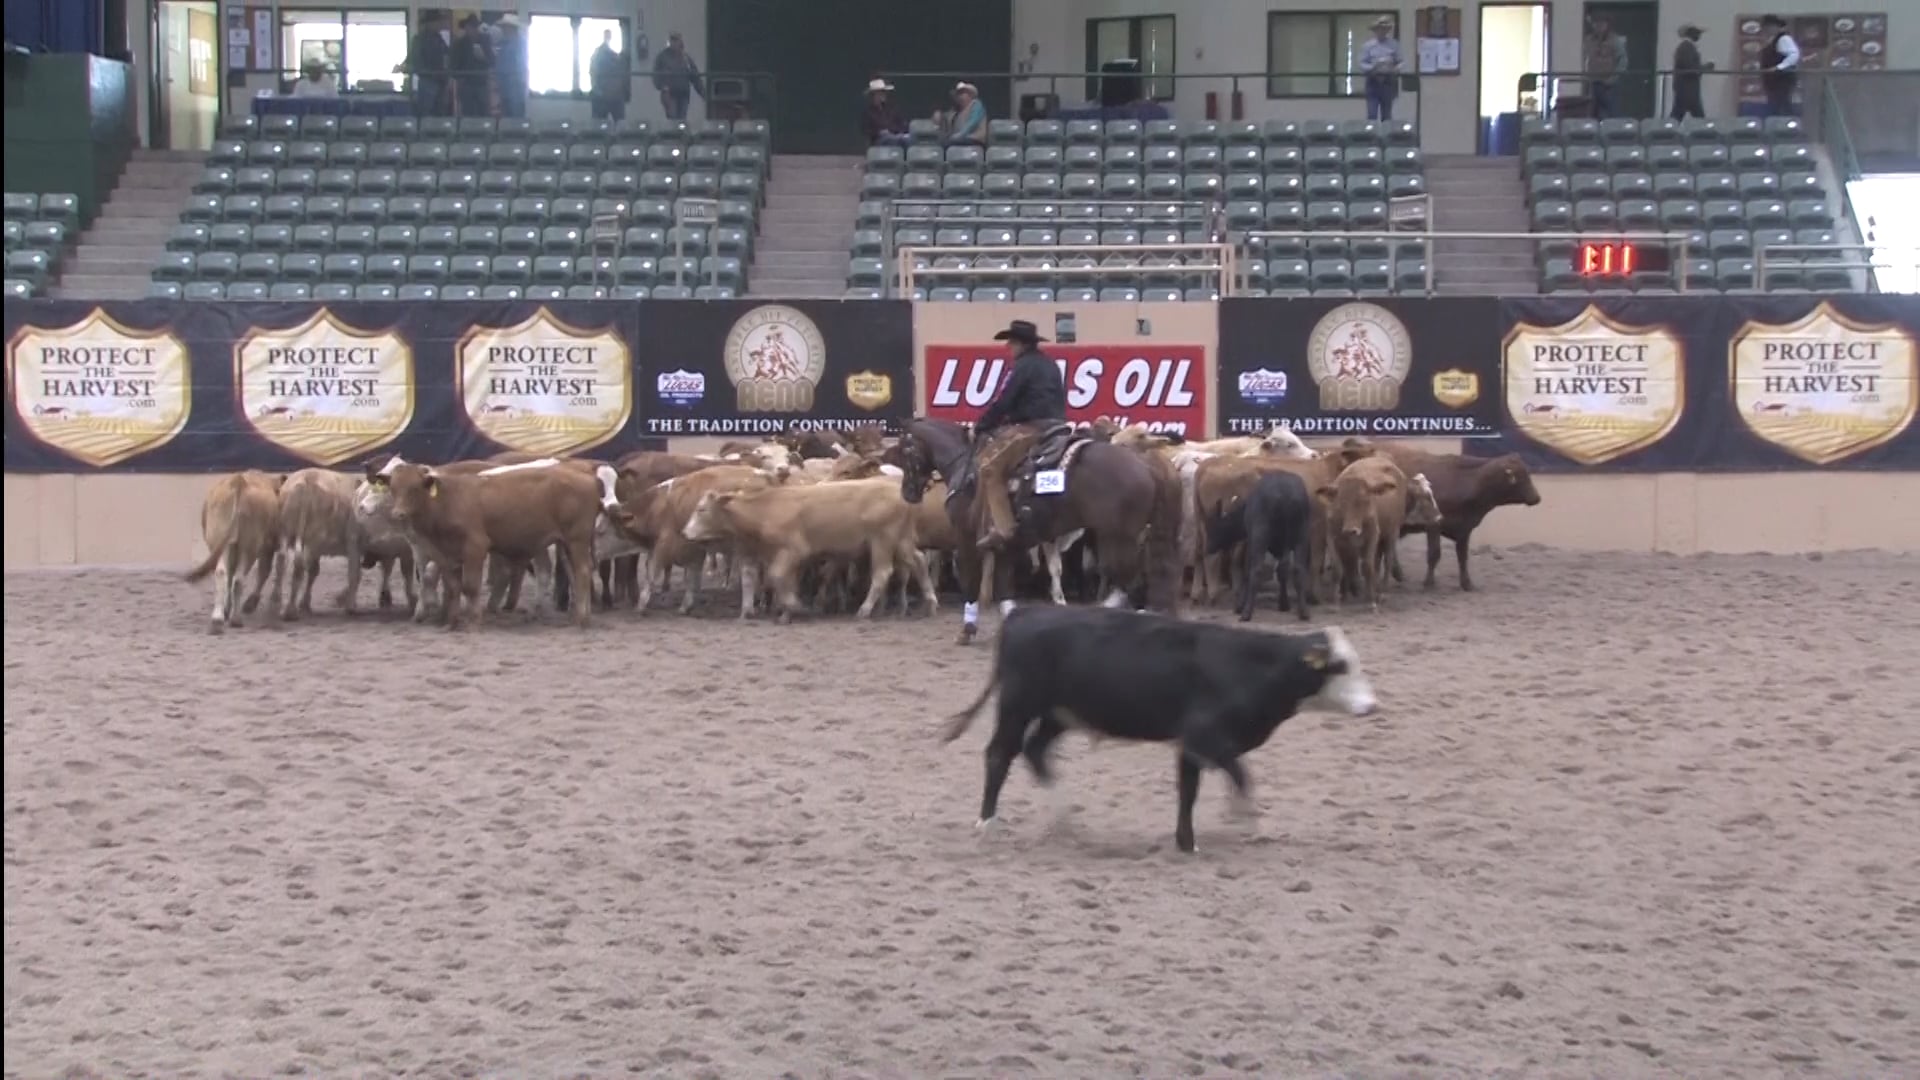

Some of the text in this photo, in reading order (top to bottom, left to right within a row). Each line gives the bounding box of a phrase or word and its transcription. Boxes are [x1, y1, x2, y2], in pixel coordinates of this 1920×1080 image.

[41, 348, 155, 366] PROTECT
[268, 347, 379, 364] PROTECT
[488, 347, 597, 364] PROTECT
[1533, 345, 1648, 362] PROTECT
[1763, 343, 1882, 360] PROTECT
[85, 367, 114, 378] THE
[308, 367, 339, 378] THE
[528, 365, 558, 376] THE
[1575, 364, 1606, 375] THE
[1806, 362, 1837, 374] THE
[43, 379, 154, 396] HARVEST
[269, 379, 378, 396] HARVEST
[490, 377, 597, 395] HARVEST
[932, 358, 1195, 407] LUS OIL
[1534, 377, 1647, 394] HARVEST
[1764, 375, 1880, 392] HARVEST
[737, 378, 814, 412] RENO
[648, 418, 683, 432] THE
[687, 418, 784, 432] TRADITION
[1228, 418, 1264, 431] THE
[1268, 417, 1367, 431] TRADITION
